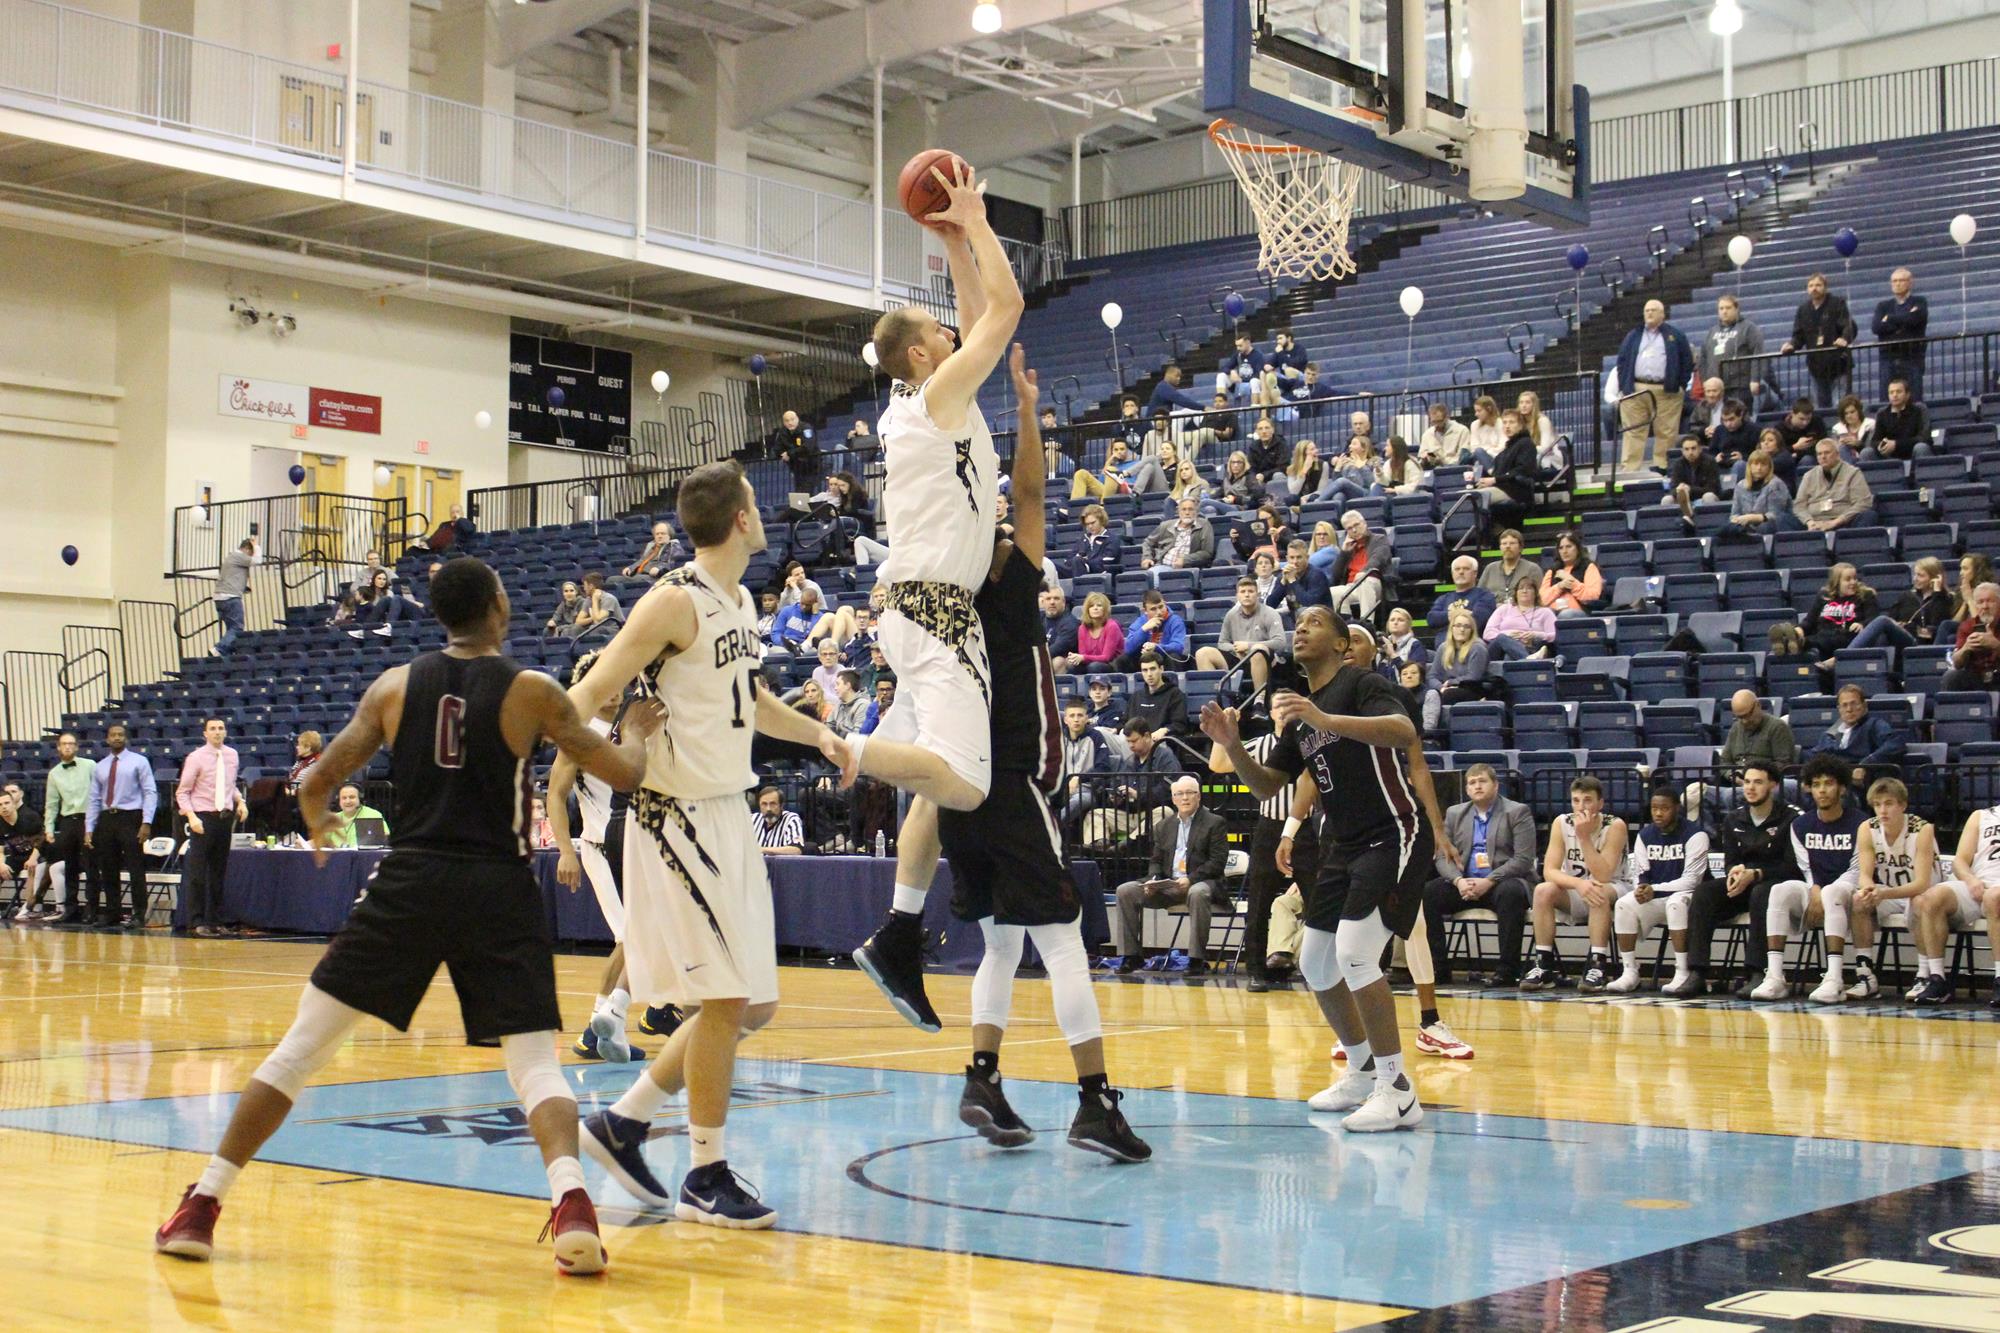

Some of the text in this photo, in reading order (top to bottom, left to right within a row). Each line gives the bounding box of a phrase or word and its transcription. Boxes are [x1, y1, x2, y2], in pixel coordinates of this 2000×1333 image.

[598, 376, 623, 389] GUEST
[1315, 753, 1334, 794] 5
[1804, 832, 1852, 850] GRACE
[1647, 844, 1684, 860] GRACE
